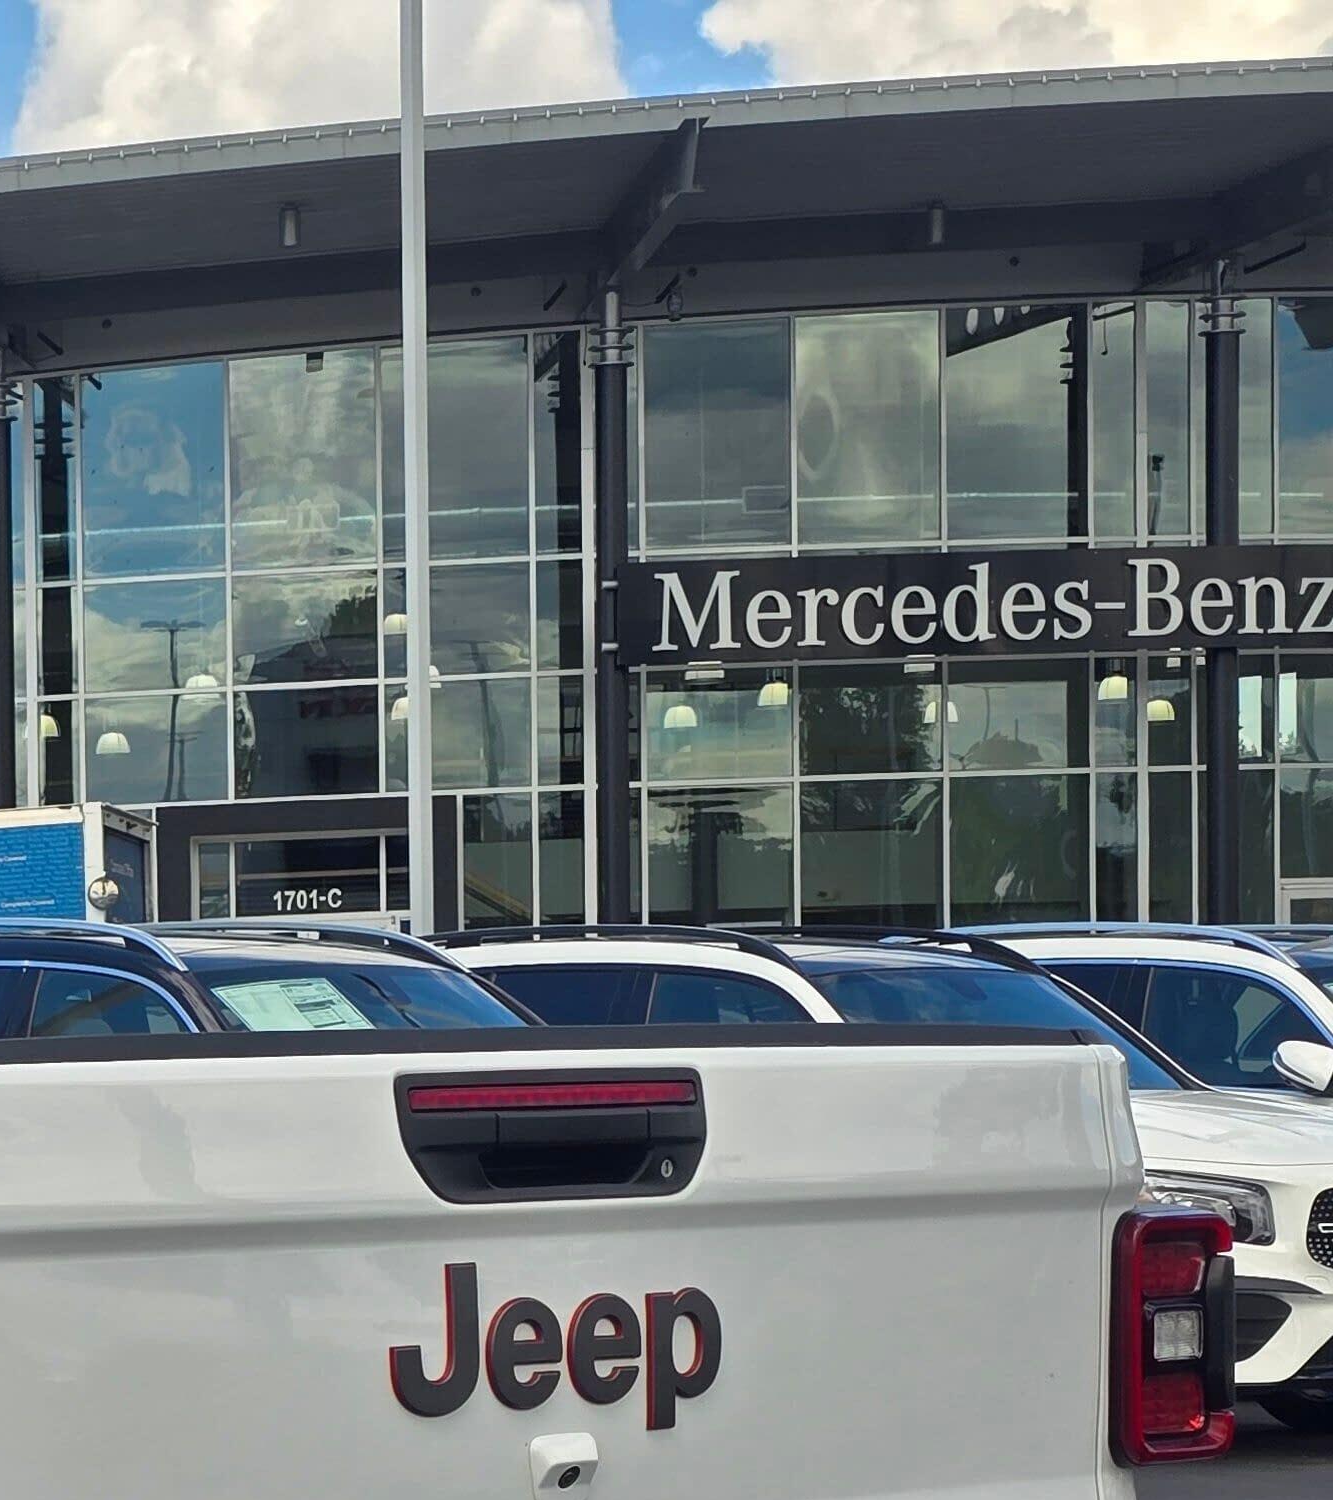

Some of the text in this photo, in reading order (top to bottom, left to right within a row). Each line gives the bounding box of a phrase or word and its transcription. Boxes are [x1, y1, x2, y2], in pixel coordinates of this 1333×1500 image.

[651, 556, 1333, 653] Mercedes-Benz
[273, 887, 343, 912] 1701-C
[389, 1261, 722, 1431] Jeep
